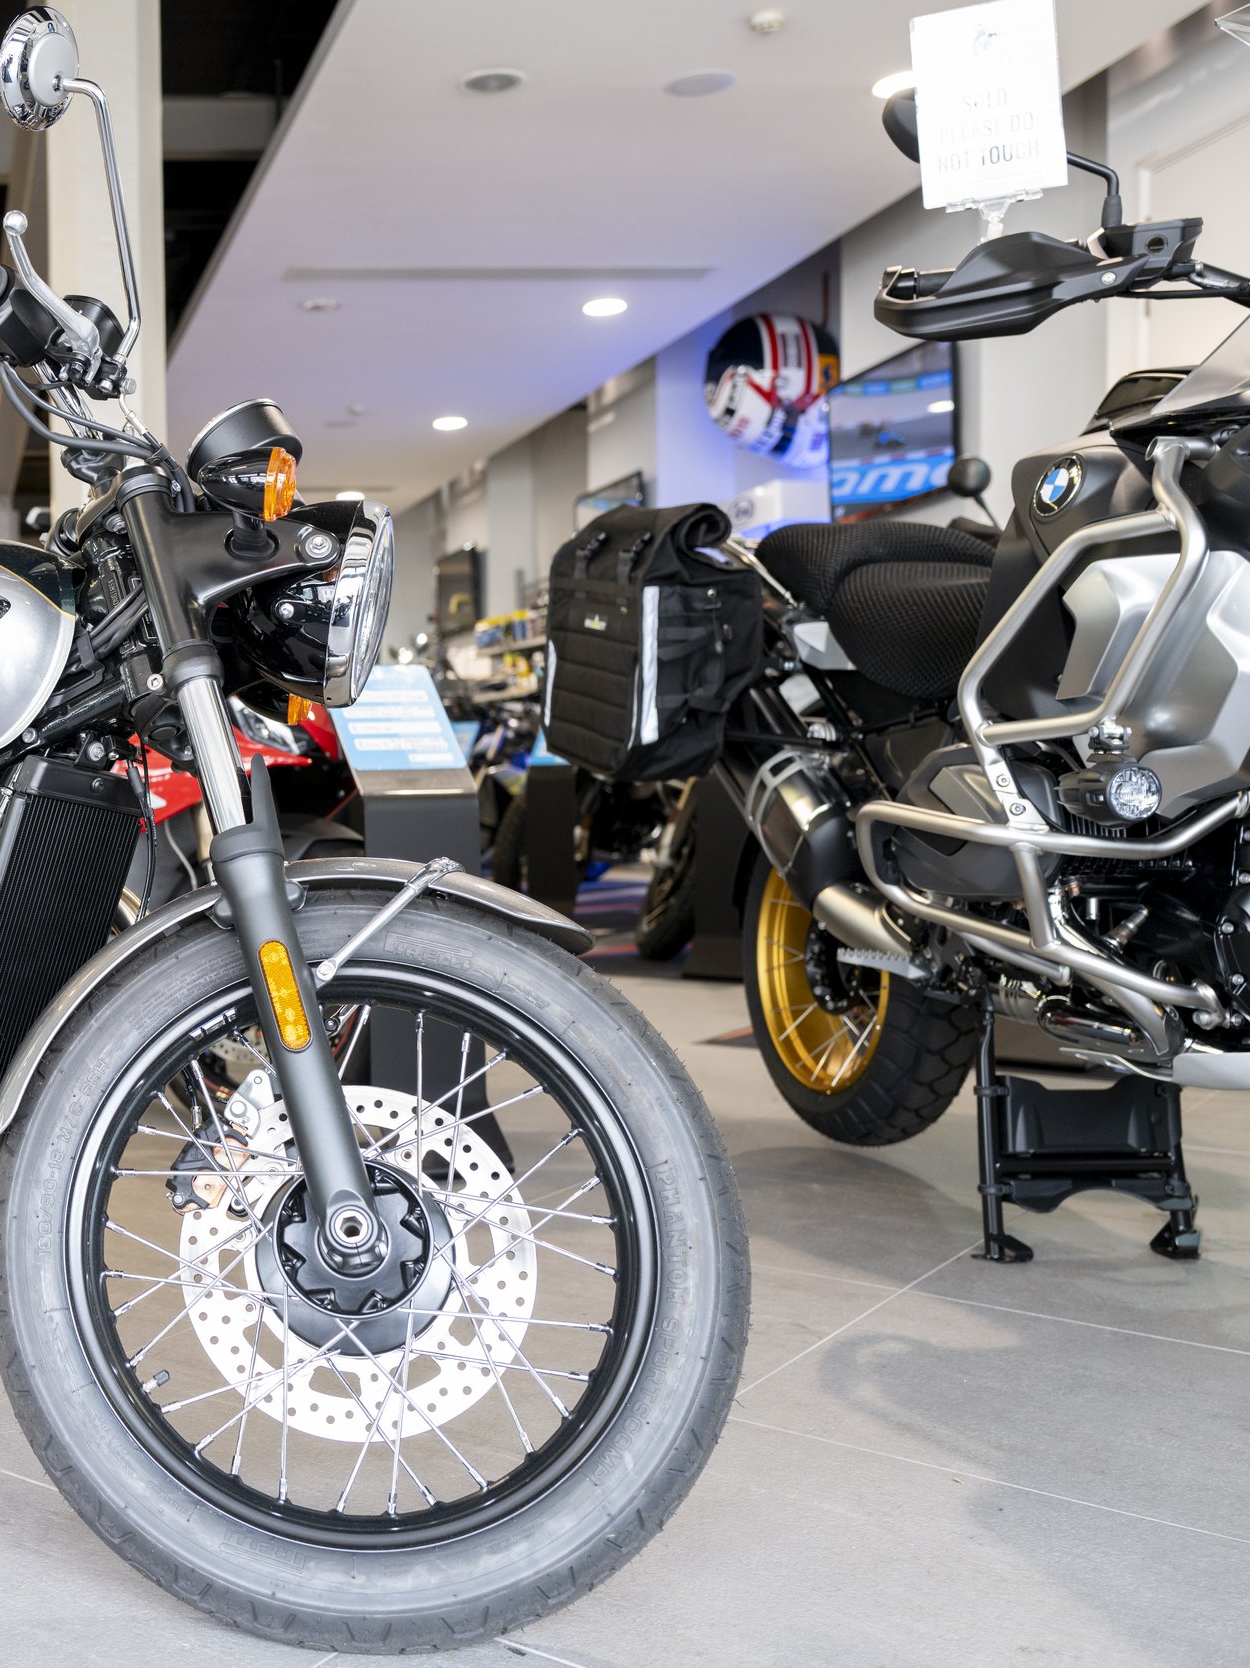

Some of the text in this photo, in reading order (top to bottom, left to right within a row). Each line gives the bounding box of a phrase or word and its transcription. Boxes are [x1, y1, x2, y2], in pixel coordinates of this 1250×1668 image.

[962, 88, 1007, 112] SOLD
[940, 112, 1034, 145] PLEASE DO
[938, 137, 1040, 175] NOT TOUCH
[38, 1059, 110, 1256] 100/90-18 M/C 56H
[655, 1168, 688, 1305] PHANTOM
